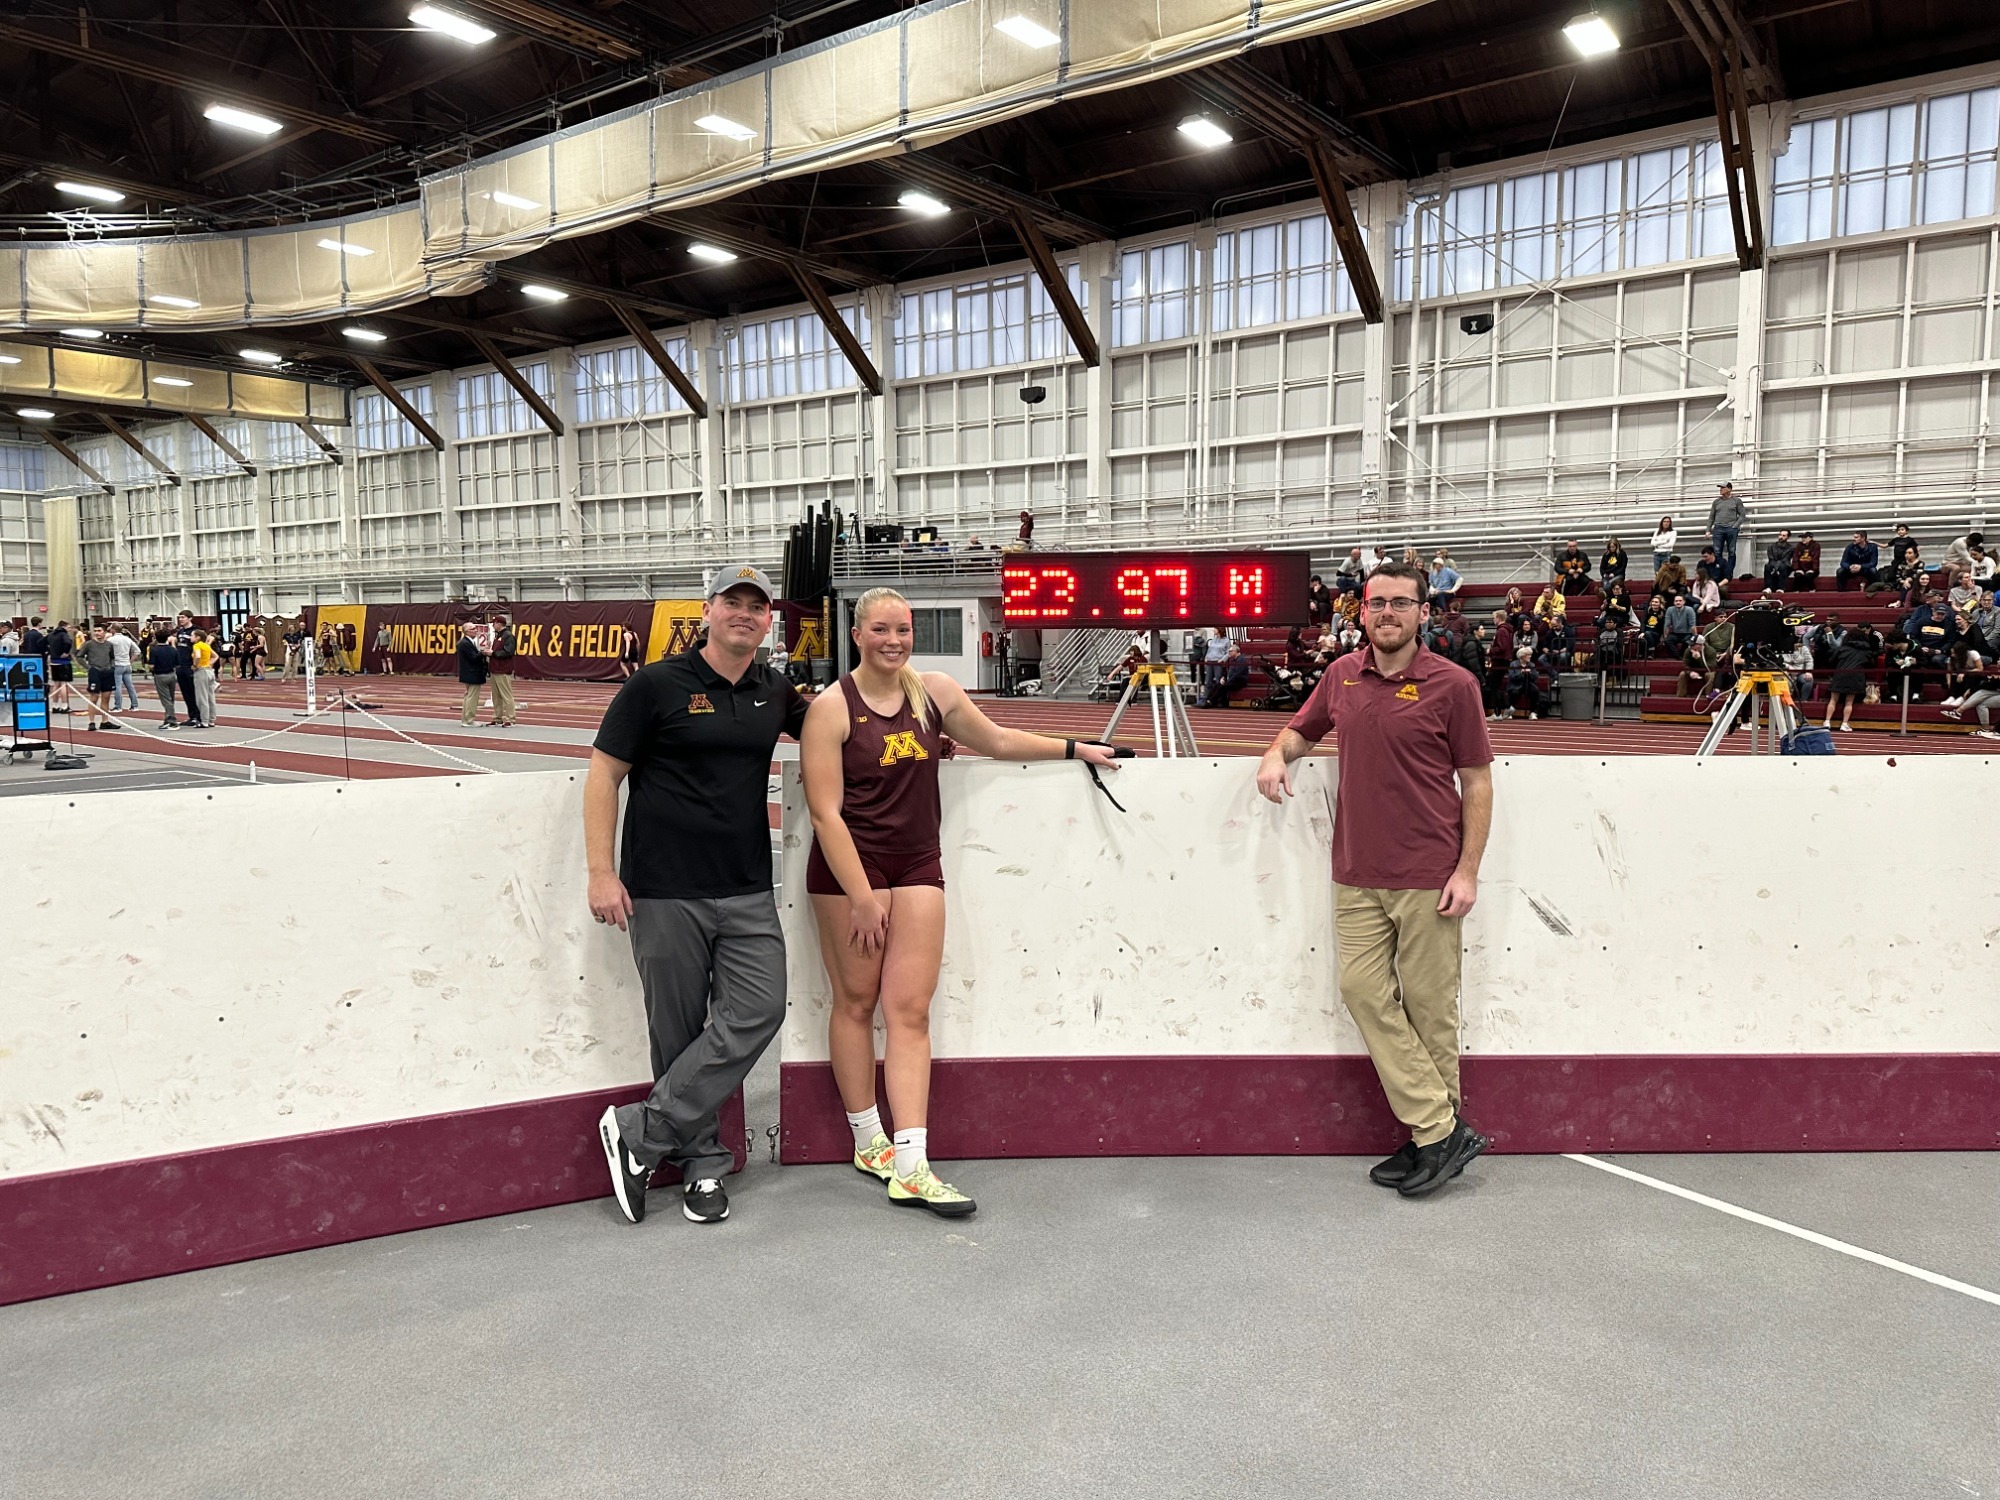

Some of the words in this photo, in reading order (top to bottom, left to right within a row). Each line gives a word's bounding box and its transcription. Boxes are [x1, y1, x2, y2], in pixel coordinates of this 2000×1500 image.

[736, 567, 759, 581] M
[1229, 568, 1262, 615] M
[386, 624, 465, 654] MINNESO
[547, 625, 563, 657] &
[569, 624, 622, 658] FIELD
[307, 640, 315, 697] FINISH
[688, 694, 714, 709] M
[879, 730, 929, 767] M
